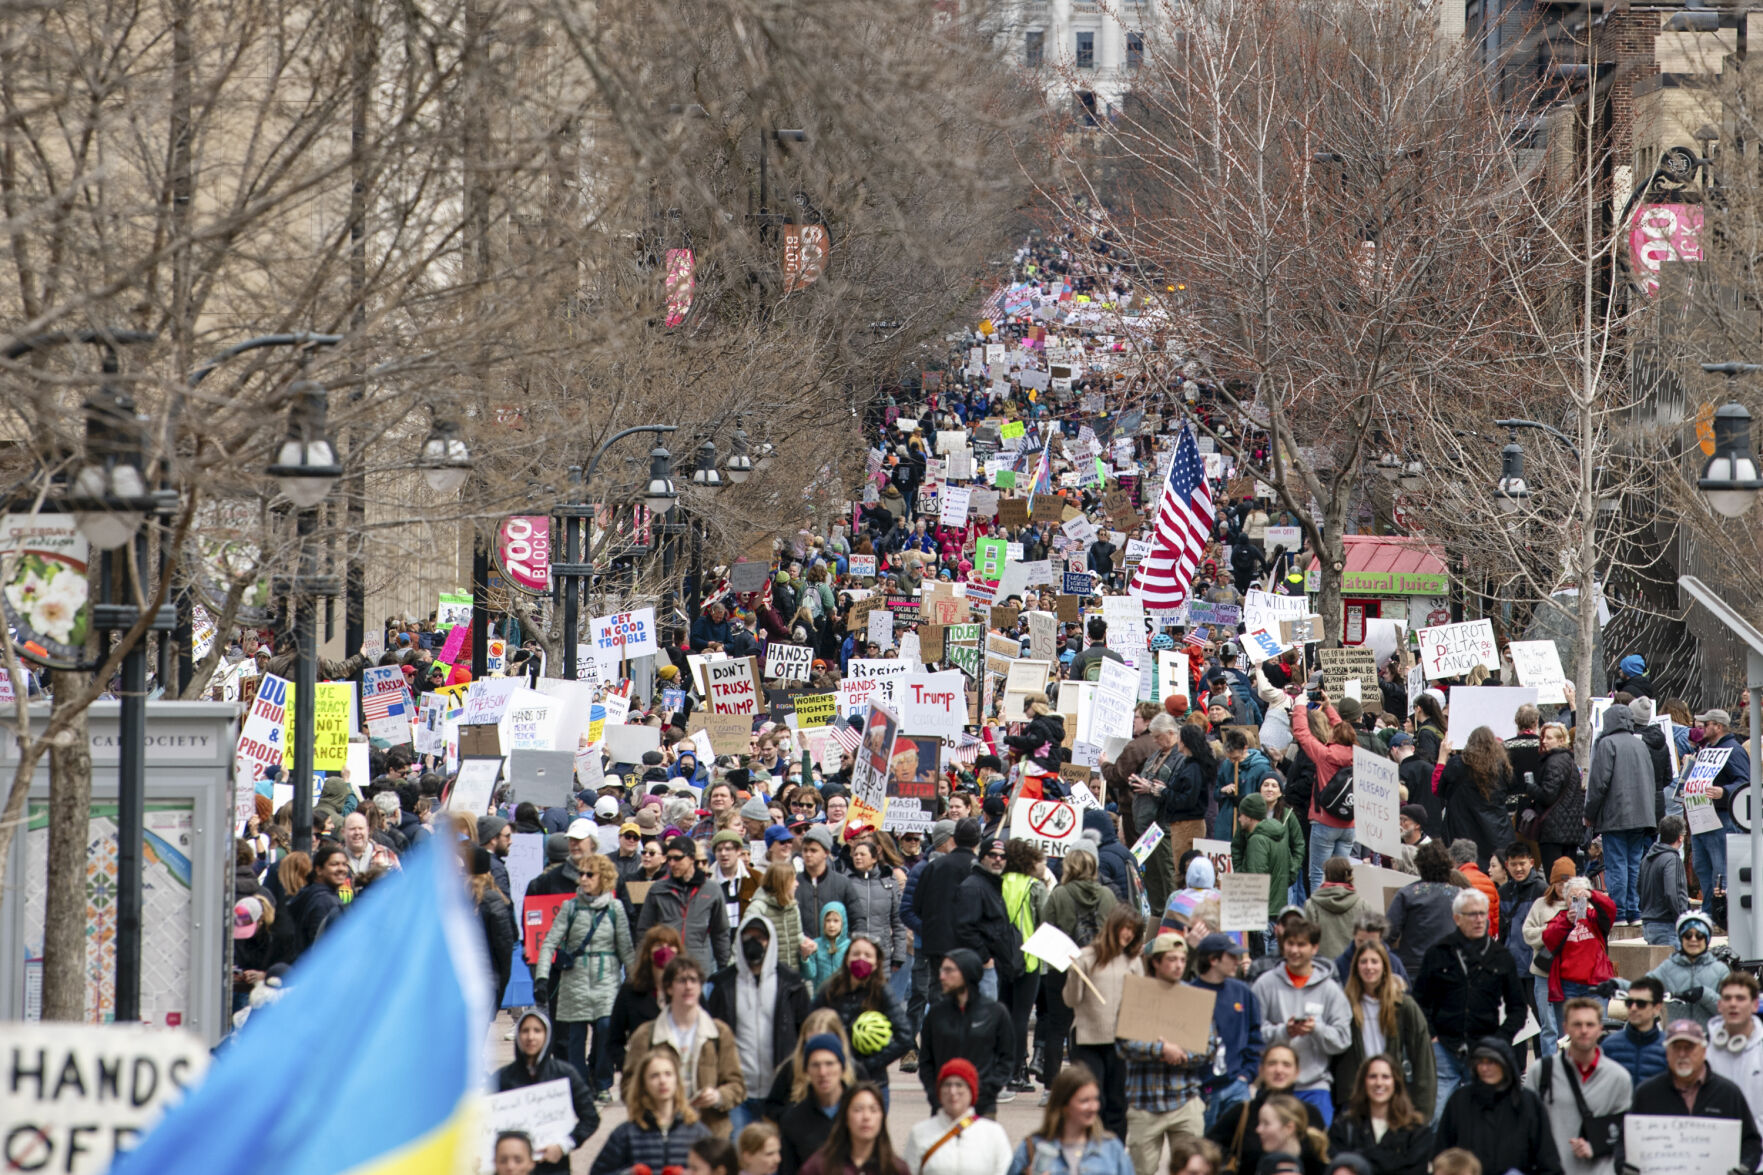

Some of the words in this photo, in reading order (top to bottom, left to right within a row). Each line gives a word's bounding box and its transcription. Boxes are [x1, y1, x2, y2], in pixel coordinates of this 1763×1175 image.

[507, 518, 532, 577] 700
[532, 530, 547, 579] BLOCK
[1399, 576, 1439, 592] Juice
[611, 612, 632, 625] GET
[1161, 616, 1180, 624] RUMP
[601, 626, 611, 638] IN
[614, 621, 644, 635] GOOD
[950, 624, 979, 640] TOUGH
[1418, 623, 1487, 648] FOXTROT
[598, 632, 647, 649] TROUBLE
[1251, 627, 1283, 657] FELON
[1436, 639, 1481, 657] DELTA
[768, 643, 812, 662] HANDS
[712, 662, 746, 680] DON'T
[774, 661, 810, 680] OFF!
[1433, 653, 1480, 672] TANGO
[374, 669, 392, 680] TO
[259, 675, 286, 706] DU
[712, 680, 754, 697] TRUSK
[843, 679, 876, 693] HANDS
[469, 694, 508, 712] TREASON
[715, 698, 754, 715] MUMP
[795, 694, 834, 706] WOMEN'S
[849, 692, 870, 705] OFF
[910, 684, 955, 712] Trump
[512, 710, 533, 723] HANDS
[796, 703, 835, 715] RIGHTS
[316, 719, 343, 731] NOT
[806, 714, 829, 725] ARE
[143, 735, 210, 746] OCIETY
[269, 728, 279, 743] &
[331, 733, 348, 745] IN
[1697, 749, 1730, 765] REJECT
[855, 762, 886, 792] HANDS
[1356, 754, 1394, 784] HISTORY
[1691, 765, 1721, 779] REFUSE
[1358, 778, 1390, 800] ALREADY
[887, 799, 919, 808] MASH
[1358, 797, 1389, 822] HATES
[885, 811, 931, 819] MERICA'S
[1364, 820, 1383, 841] YOU
